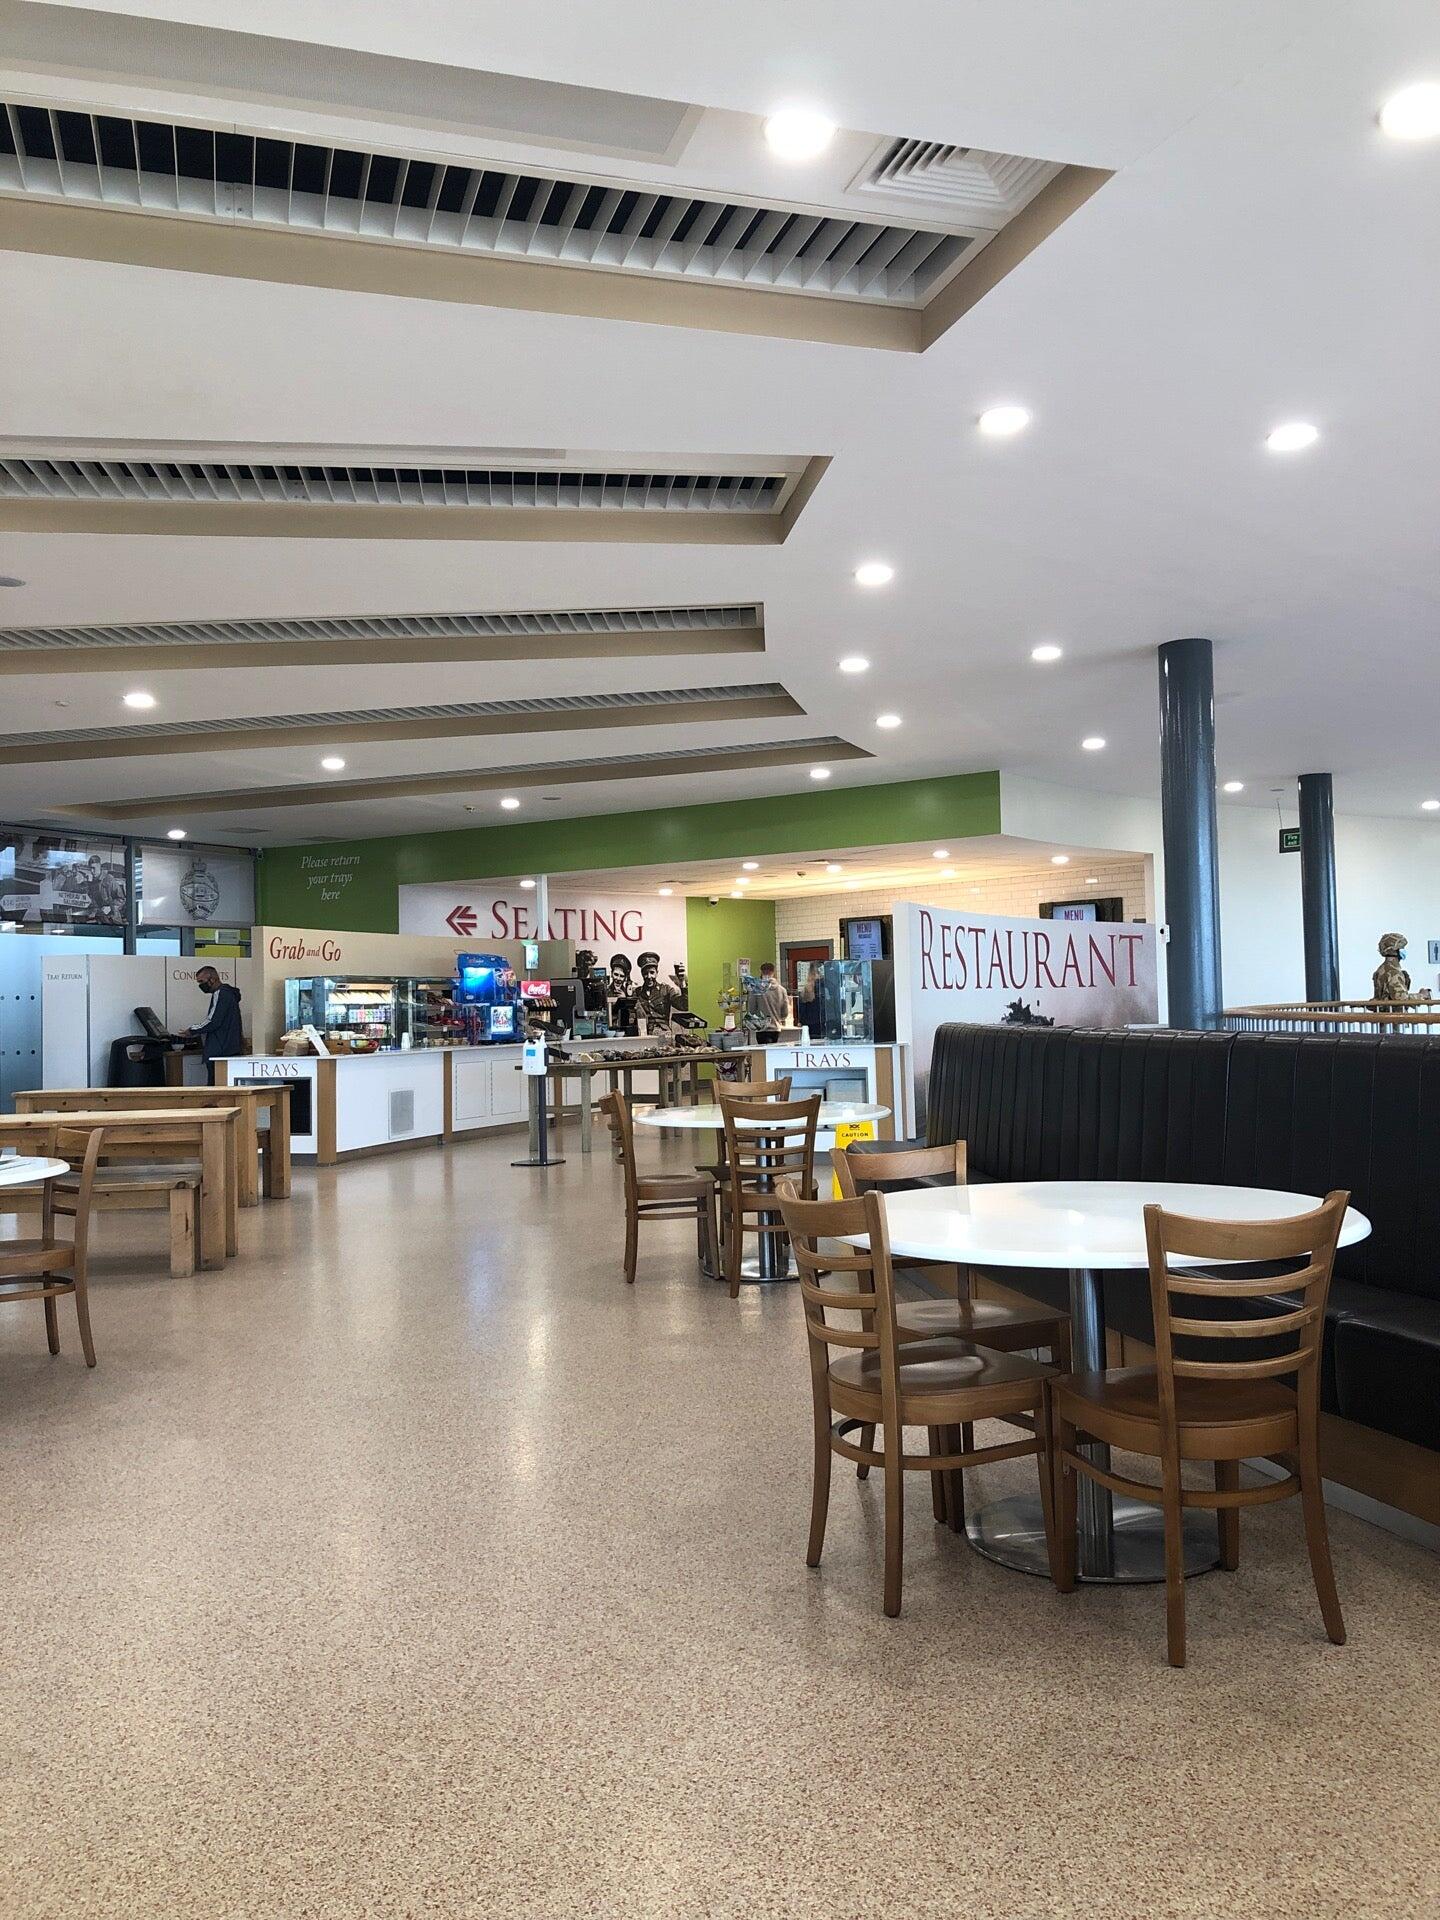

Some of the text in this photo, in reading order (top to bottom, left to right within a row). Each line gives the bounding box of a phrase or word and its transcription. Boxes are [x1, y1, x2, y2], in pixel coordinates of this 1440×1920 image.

[300, 855, 360, 869] Please return
[306, 873, 353, 890] your trays
[320, 887, 341, 900] here
[1064, 910, 1084, 921] MENU
[269, 936, 342, 962] Grab and Go
[918, 909, 1144, 990] RESTAURANT
[790, 1051, 852, 1068] TRAYS
[247, 1061, 299, 1077] TRAYS
